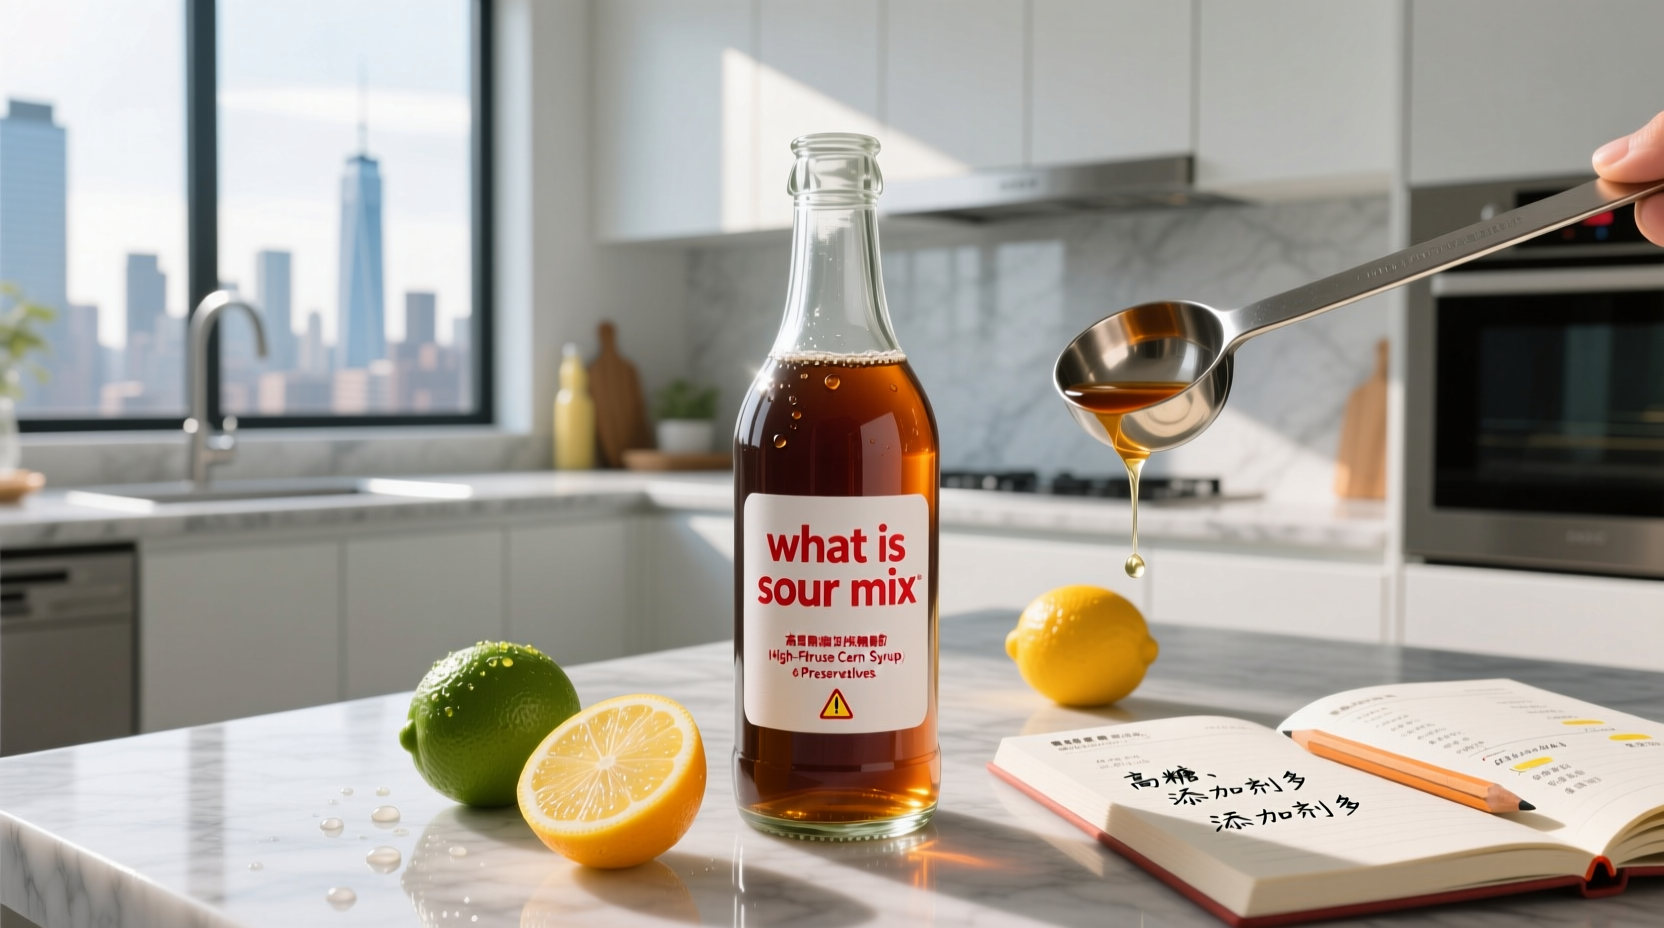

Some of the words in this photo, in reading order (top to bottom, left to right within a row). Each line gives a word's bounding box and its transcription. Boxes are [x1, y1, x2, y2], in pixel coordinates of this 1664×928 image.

[767, 524, 868, 564] what
[878, 523, 906, 563] is
[757, 575, 840, 607] sour
